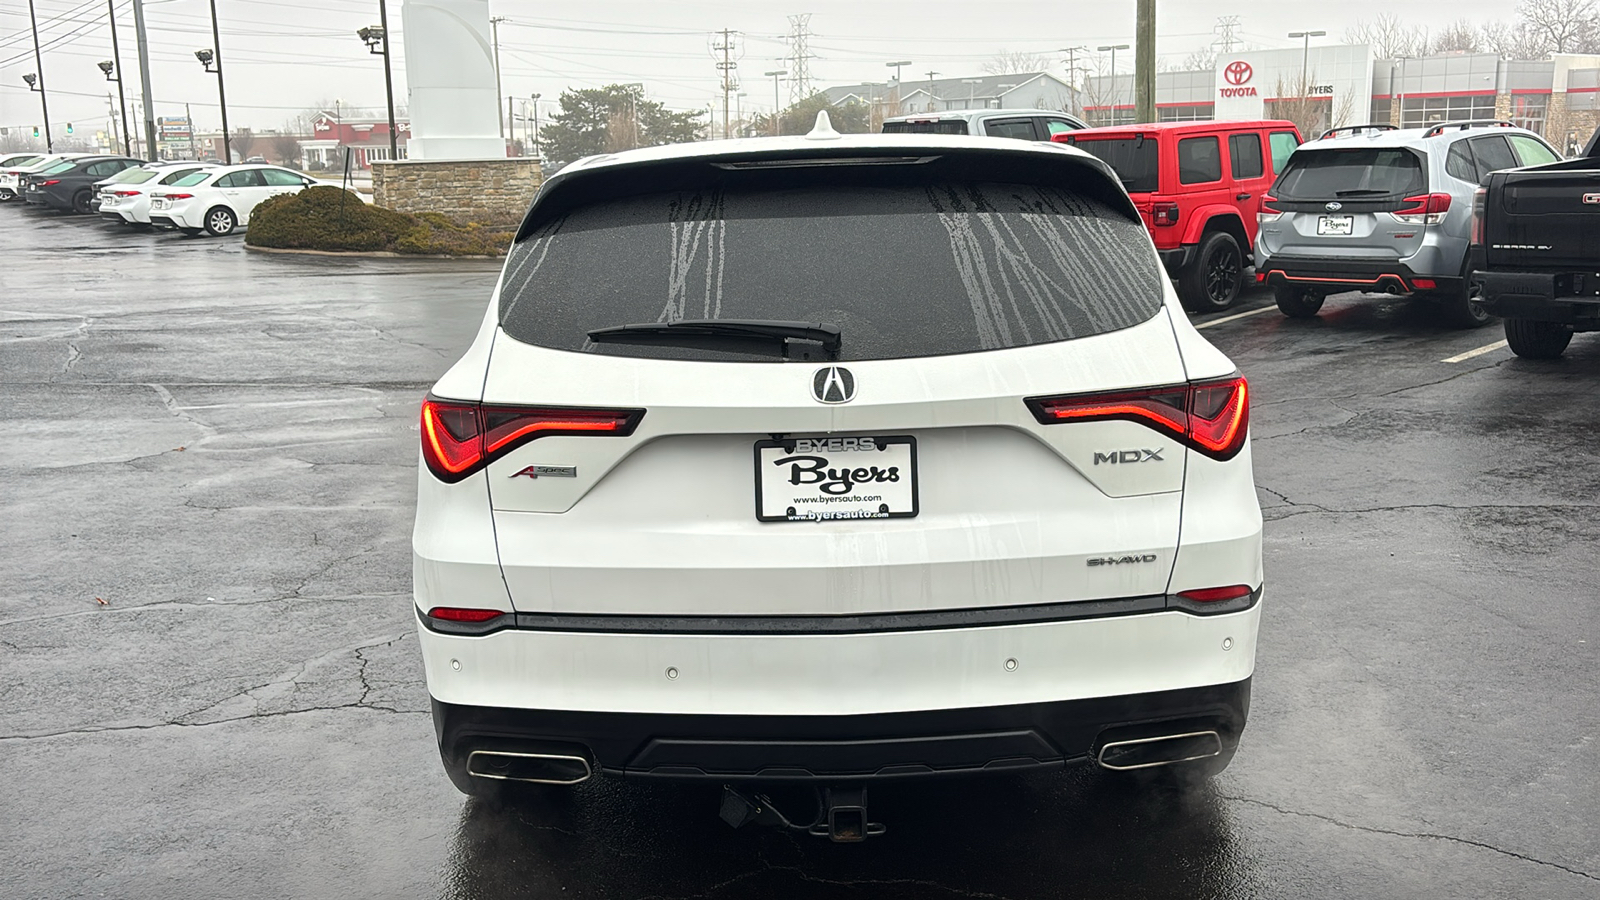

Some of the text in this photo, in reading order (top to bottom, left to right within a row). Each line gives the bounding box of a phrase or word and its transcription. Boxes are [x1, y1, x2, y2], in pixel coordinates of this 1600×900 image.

[1219, 87, 1257, 98] TOYOTA
[1308, 85, 1334, 95] BYERS
[1322, 219, 1349, 230] Byers
[795, 437, 876, 454] BYERS
[1093, 446, 1164, 466] MDX
[773, 455, 900, 495] Byers
[793, 494, 882, 505] www.byersauto.com
[787, 508, 889, 523] www.byersauto.com
[1086, 553, 1157, 567] SH-AWD
